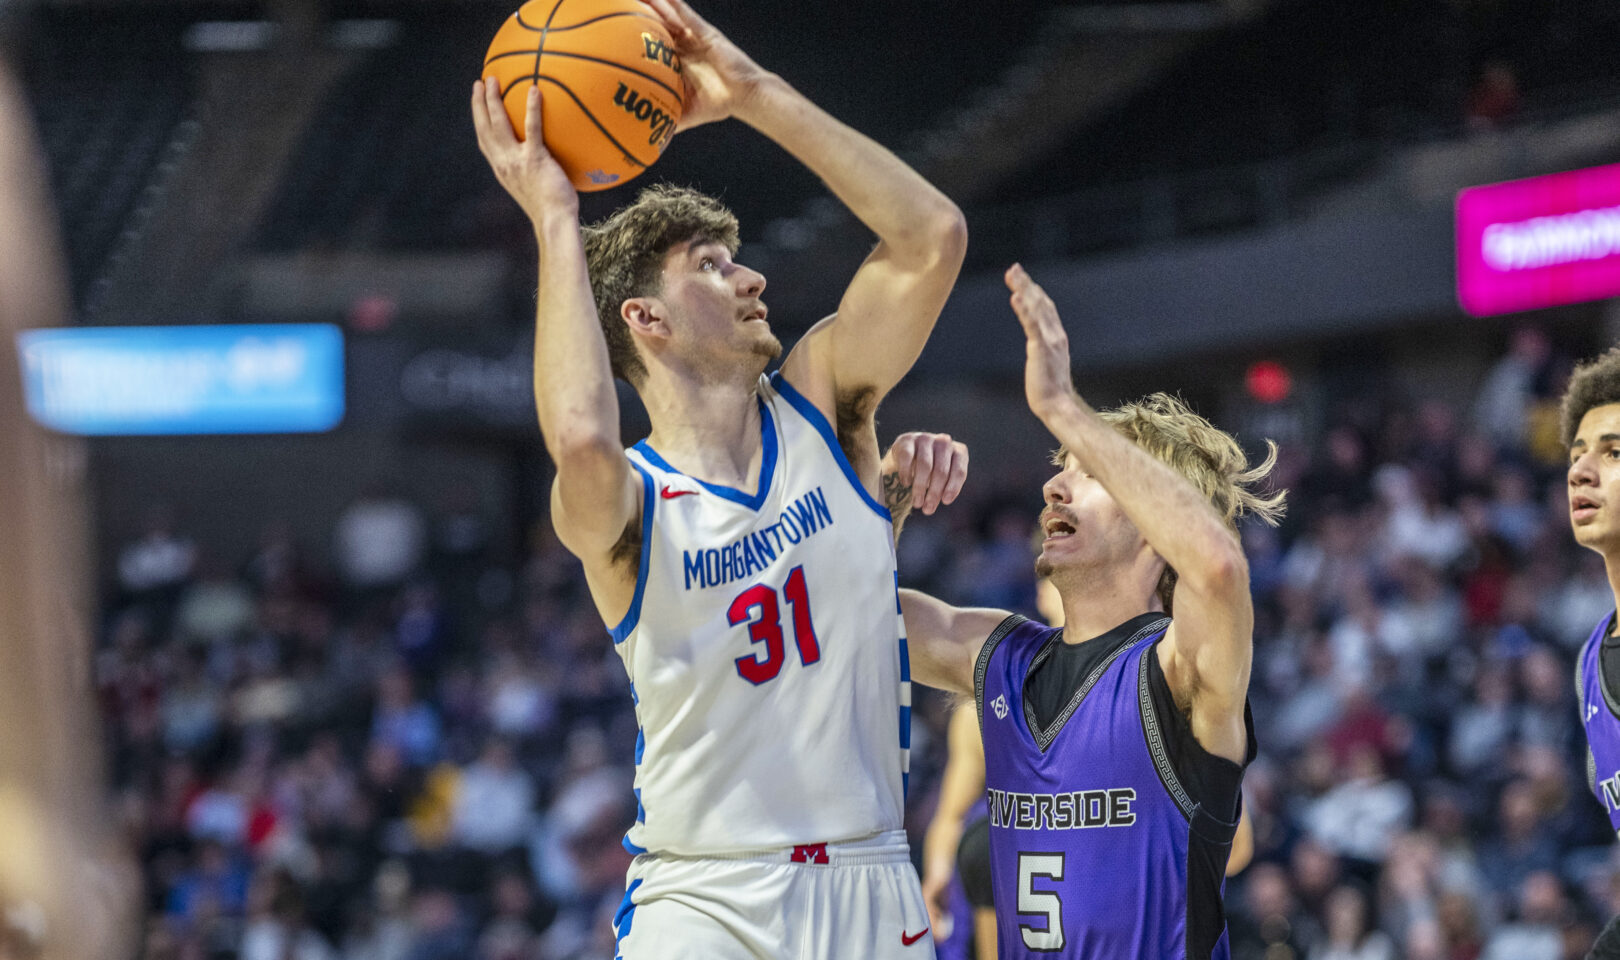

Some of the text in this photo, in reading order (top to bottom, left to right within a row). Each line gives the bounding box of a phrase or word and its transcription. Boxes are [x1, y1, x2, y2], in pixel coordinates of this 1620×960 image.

[641, 32, 683, 76] CAA
[683, 486, 833, 590] MORGANTOWN
[726, 564, 820, 686] 31
[790, 842, 829, 865] M
[1016, 851, 1067, 953] 5
